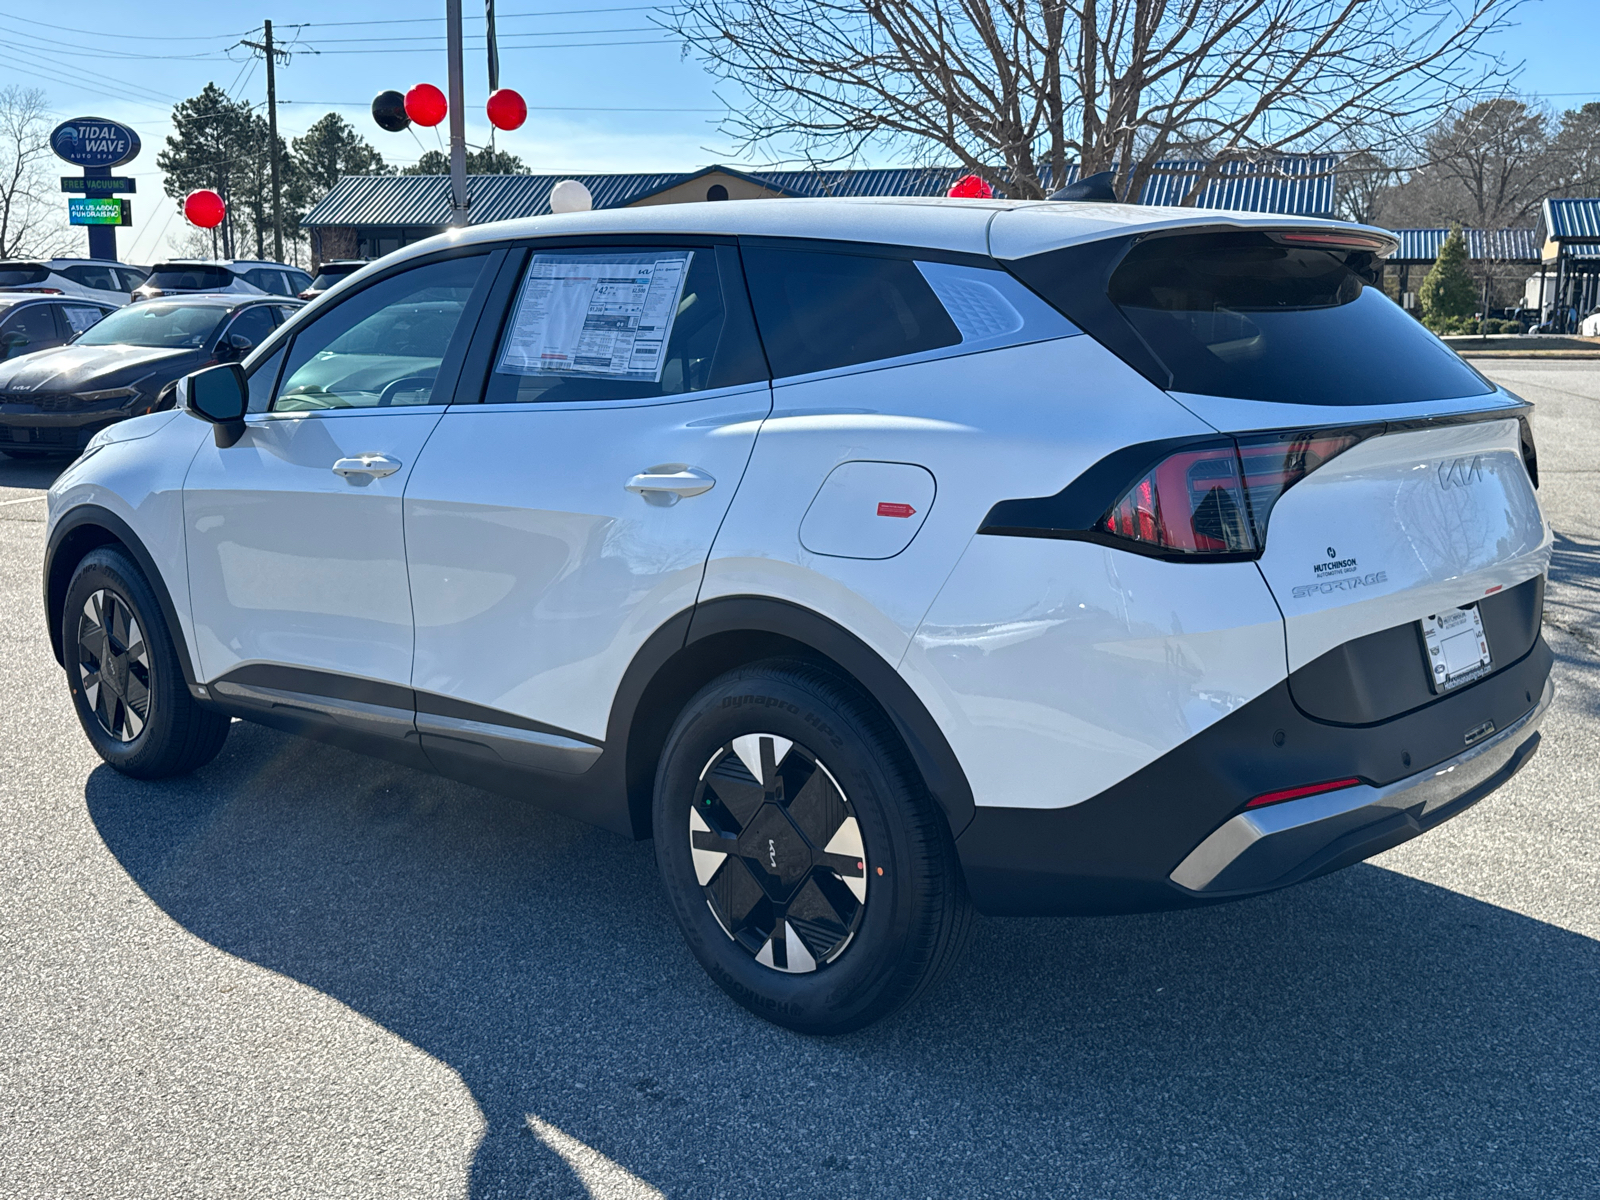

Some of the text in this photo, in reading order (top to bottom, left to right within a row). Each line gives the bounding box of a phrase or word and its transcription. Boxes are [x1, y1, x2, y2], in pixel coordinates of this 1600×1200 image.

[79, 127, 116, 139] TIDAL
[86, 140, 125, 152] WAVE
[64, 180, 124, 189] FREE VACUUMS
[1437, 455, 1483, 491] KIA
[1313, 558, 1357, 573] HUTCHINSON
[1316, 566, 1357, 578] AUTOMOTIVE GROUP
[1291, 571, 1388, 598] SPORTAGE
[722, 694, 844, 749] Dynapro HP2
